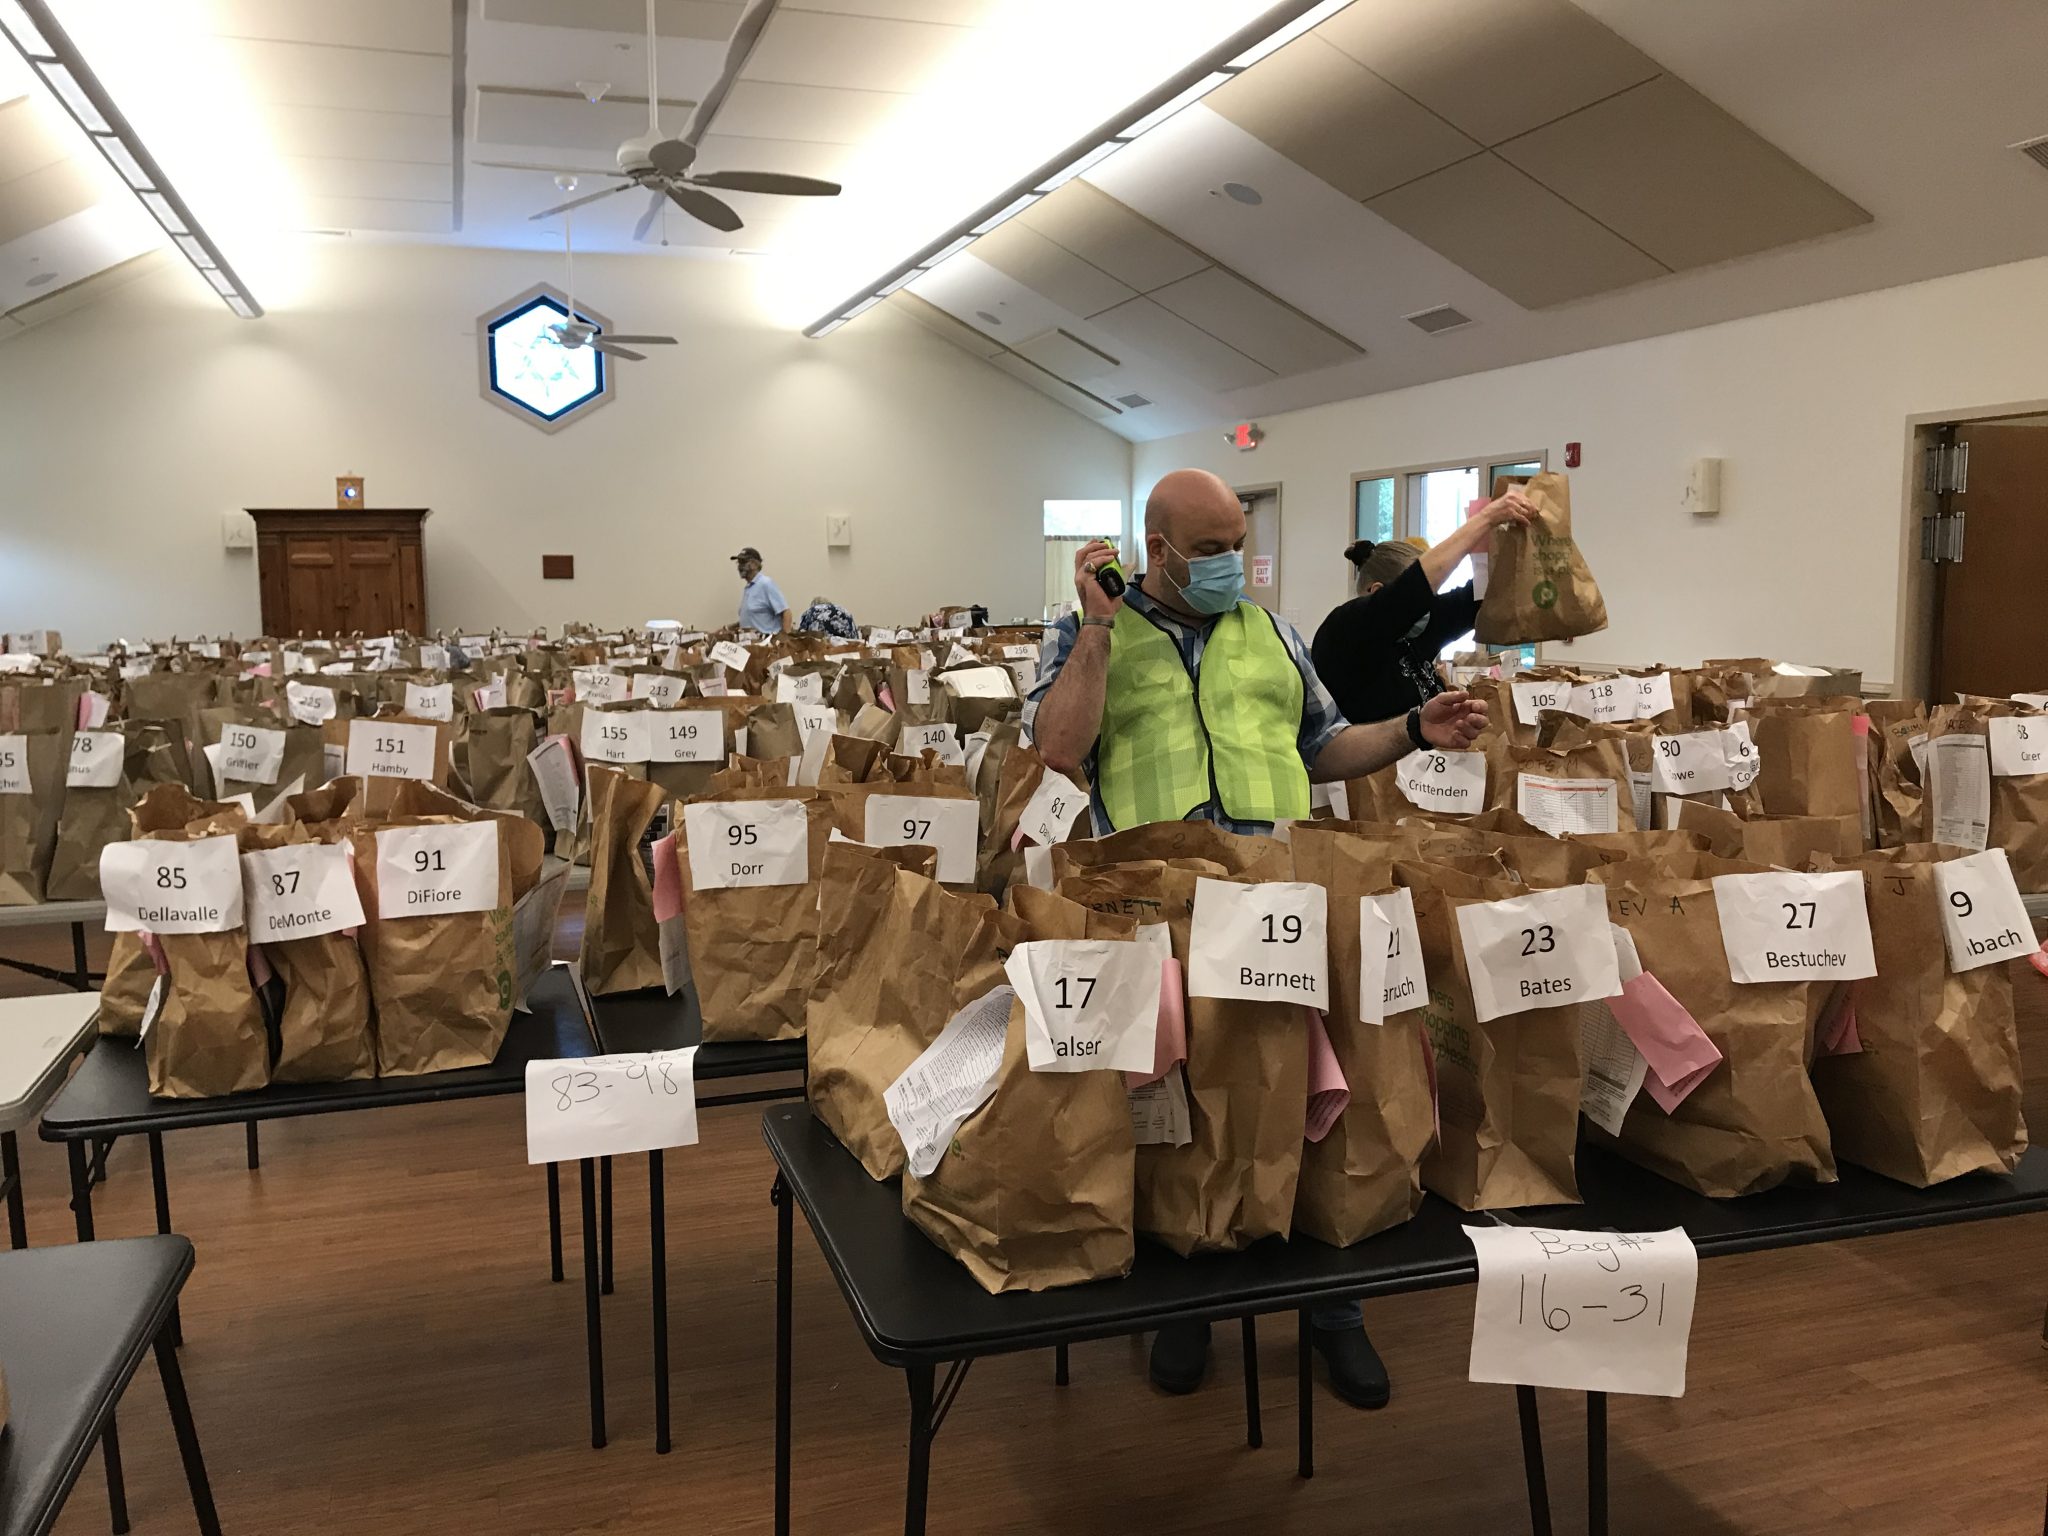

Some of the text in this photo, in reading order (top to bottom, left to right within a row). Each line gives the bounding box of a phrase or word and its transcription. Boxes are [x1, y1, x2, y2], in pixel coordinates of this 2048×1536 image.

[1256, 567, 1268, 575] EXIT
[1255, 576, 1269, 584] ONLY
[591, 675, 610, 686] 122
[1638, 683, 1652, 695] 16
[649, 685, 669, 697] 213
[1589, 685, 1613, 700] 118
[420, 697, 437, 708] 211
[1531, 694, 1556, 707] 105
[1593, 705, 1616, 714] Forfar
[803, 717, 823, 729] 147
[230, 732, 256, 749] 150
[601, 725, 628, 740] 155
[669, 725, 698, 740] 149
[923, 730, 946, 745] 140
[72, 737, 92, 752] 78
[375, 738, 405, 754] 151
[1740, 741, 1750, 757] 6
[606, 748, 625, 759] Hart
[674, 748, 697, 760] Grey
[372, 762, 409, 776] Hamby
[1425, 754, 1447, 774] 78
[1408, 779, 1469, 798] Crittenden
[1051, 797, 1066, 820] 81
[728, 824, 758, 846] 95
[903, 819, 931, 841] 97
[413, 849, 446, 872] 91
[731, 862, 764, 876] Dorr
[156, 867, 187, 889] 85
[272, 871, 300, 896] 87
[407, 888, 462, 905] DiFiore
[138, 906, 219, 923] Dellavalle
[269, 908, 331, 931] DeMonte
[1782, 902, 1817, 929] 27
[1261, 913, 1303, 944] 19
[1520, 925, 1556, 956] 23
[1765, 949, 1847, 969] Bestuchev
[1240, 967, 1316, 993] Barnett
[1519, 976, 1572, 997] Bates
[1054, 977, 1097, 1009] 17
[1383, 976, 1415, 1003] aruch
[1050, 1036, 1102, 1057] alser
[551, 1062, 678, 1112] 83-98
[1530, 1230, 1621, 1272] Bag
[1518, 1273, 1666, 1332] 16-31
